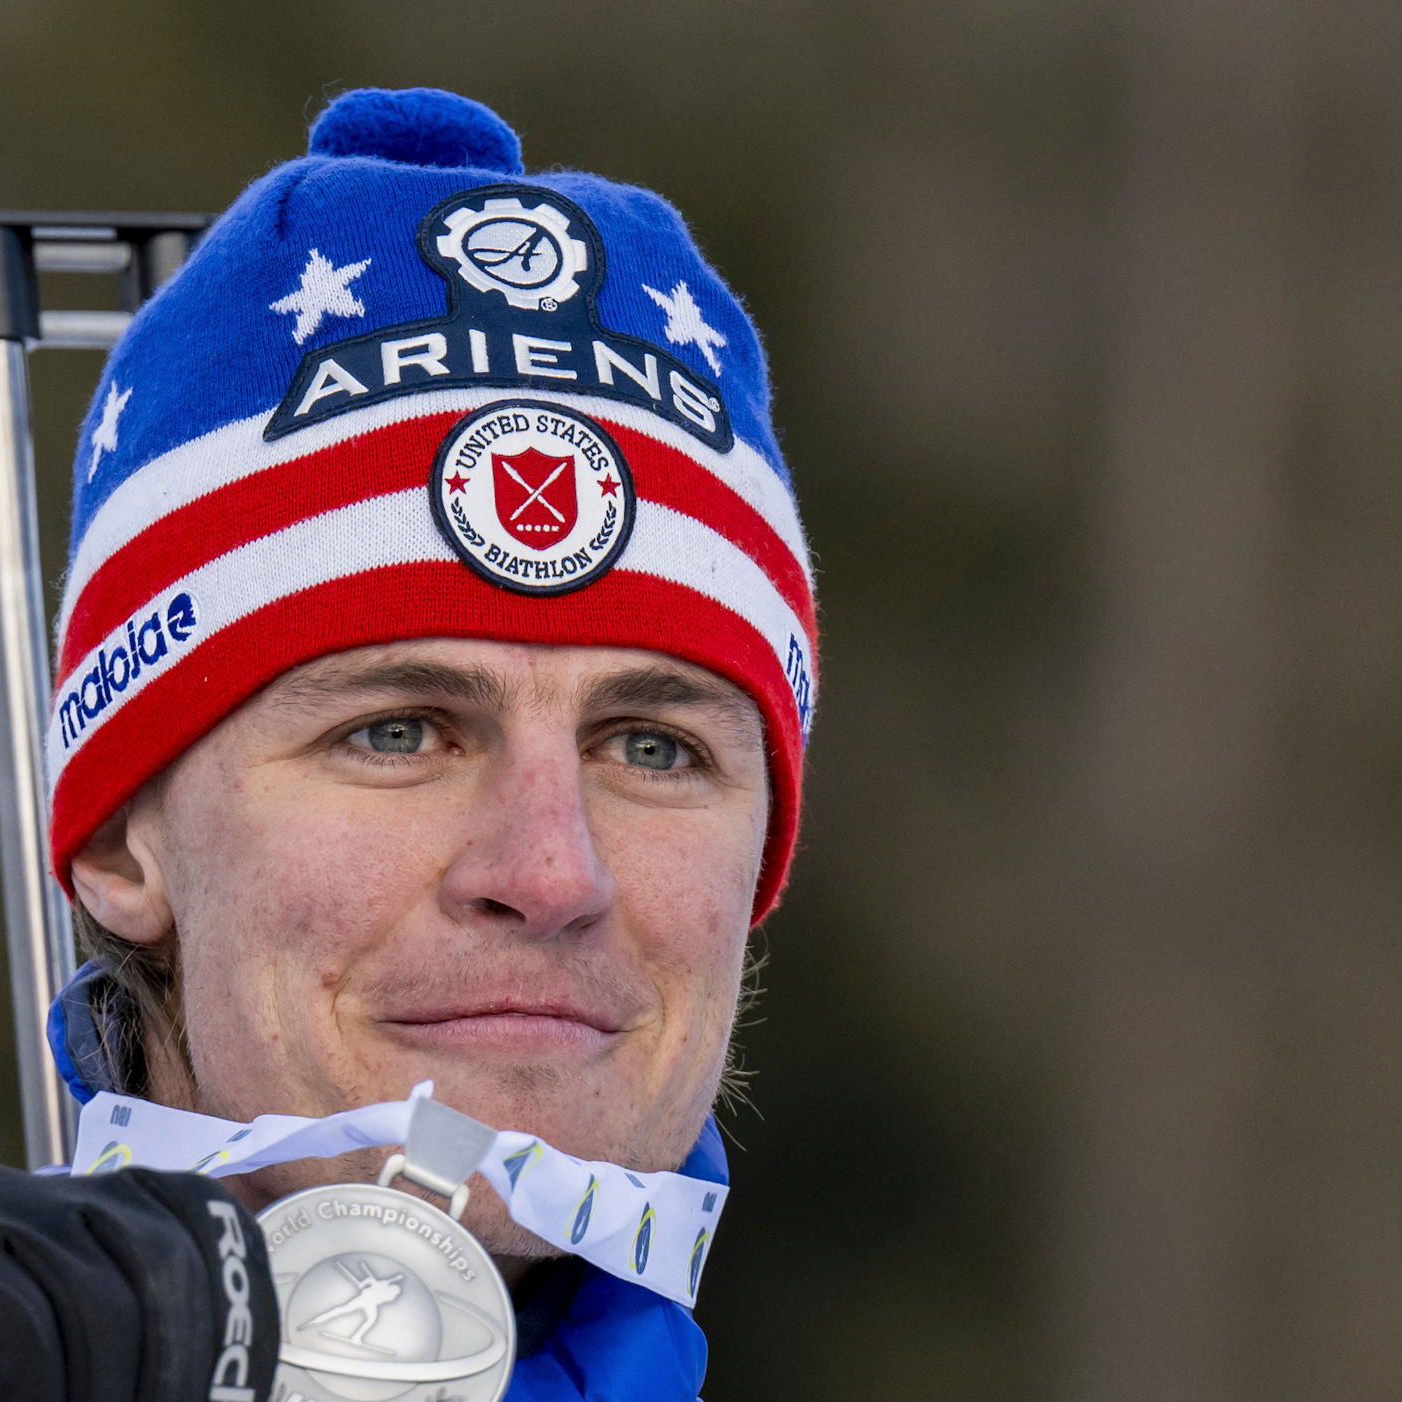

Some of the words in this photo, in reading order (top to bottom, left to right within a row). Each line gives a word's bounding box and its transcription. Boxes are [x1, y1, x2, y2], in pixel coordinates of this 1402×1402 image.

[294, 328, 717, 433] ARIENS
[455, 413, 530, 470] UNITED
[536, 414, 610, 472] STATES
[484, 543, 593, 579] BIATHLON
[59, 611, 168, 749] maloja
[317, 1199, 476, 1282] Championships
